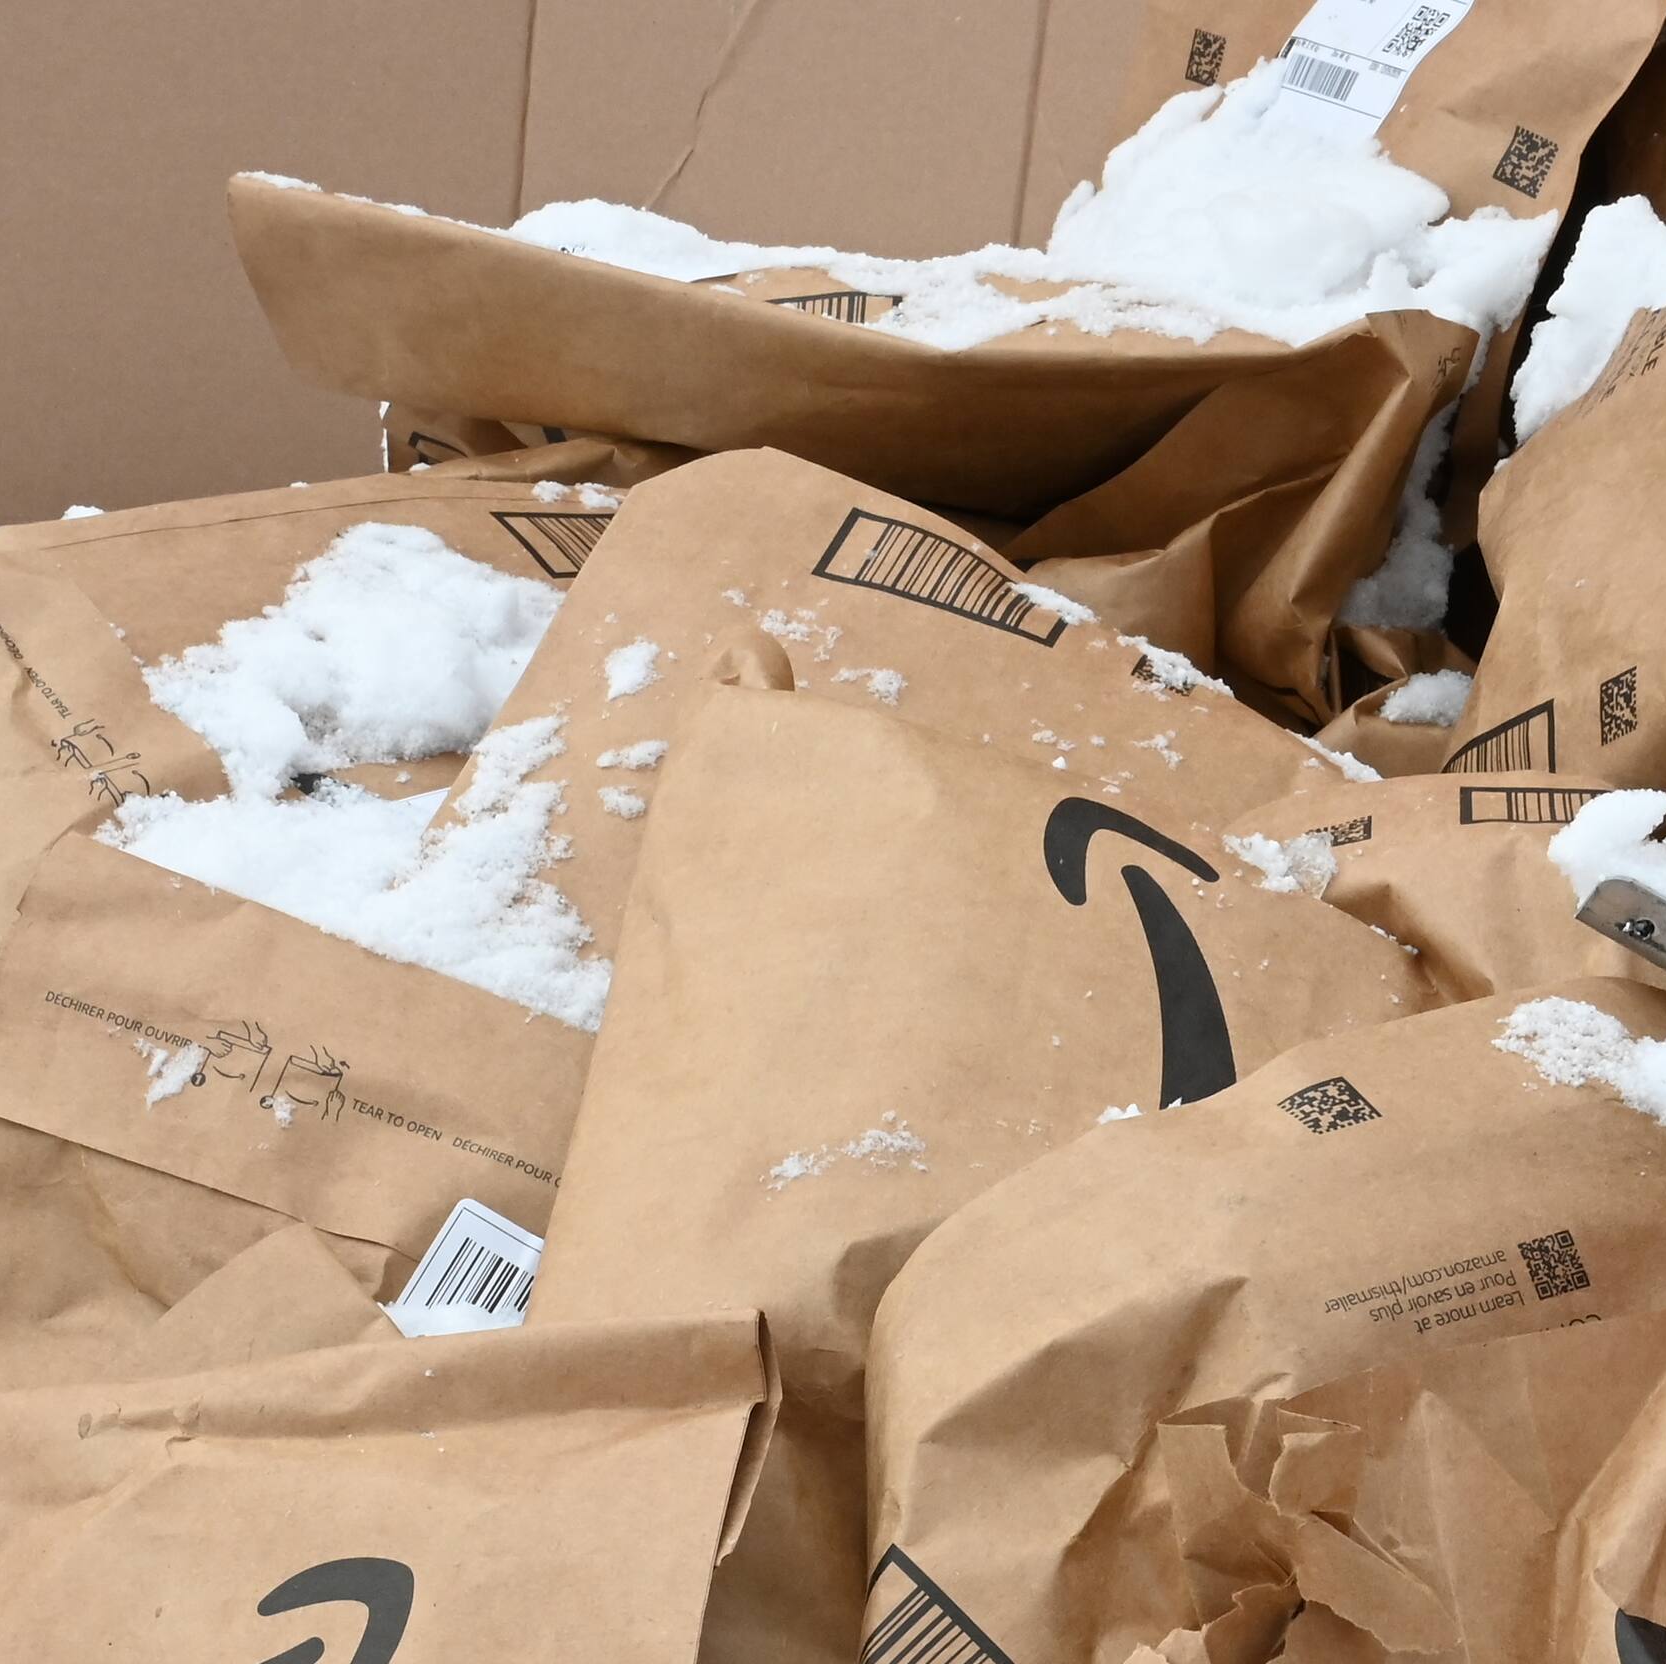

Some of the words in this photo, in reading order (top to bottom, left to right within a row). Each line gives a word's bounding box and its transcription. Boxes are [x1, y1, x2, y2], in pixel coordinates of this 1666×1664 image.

[106, 1011, 142, 1033] POUR
[352, 1098, 385, 1121] TEAR
[386, 1111, 405, 1128] TO
[407, 1121, 443, 1142] OPEN
[452, 1136, 514, 1167] DÉCHIRER
[515, 1159, 553, 1185] POUR
[1324, 1250, 1507, 1315] amazon.com/thismailer
[1456, 1281, 1475, 1297] en
[1482, 1269, 1517, 1288] Pour
[1369, 1299, 1405, 1323] plus
[1408, 1287, 1453, 1313] savoir
[1482, 1290, 1526, 1314] Learn
[1413, 1319, 1432, 1335] at
[1435, 1306, 1477, 1327] more
